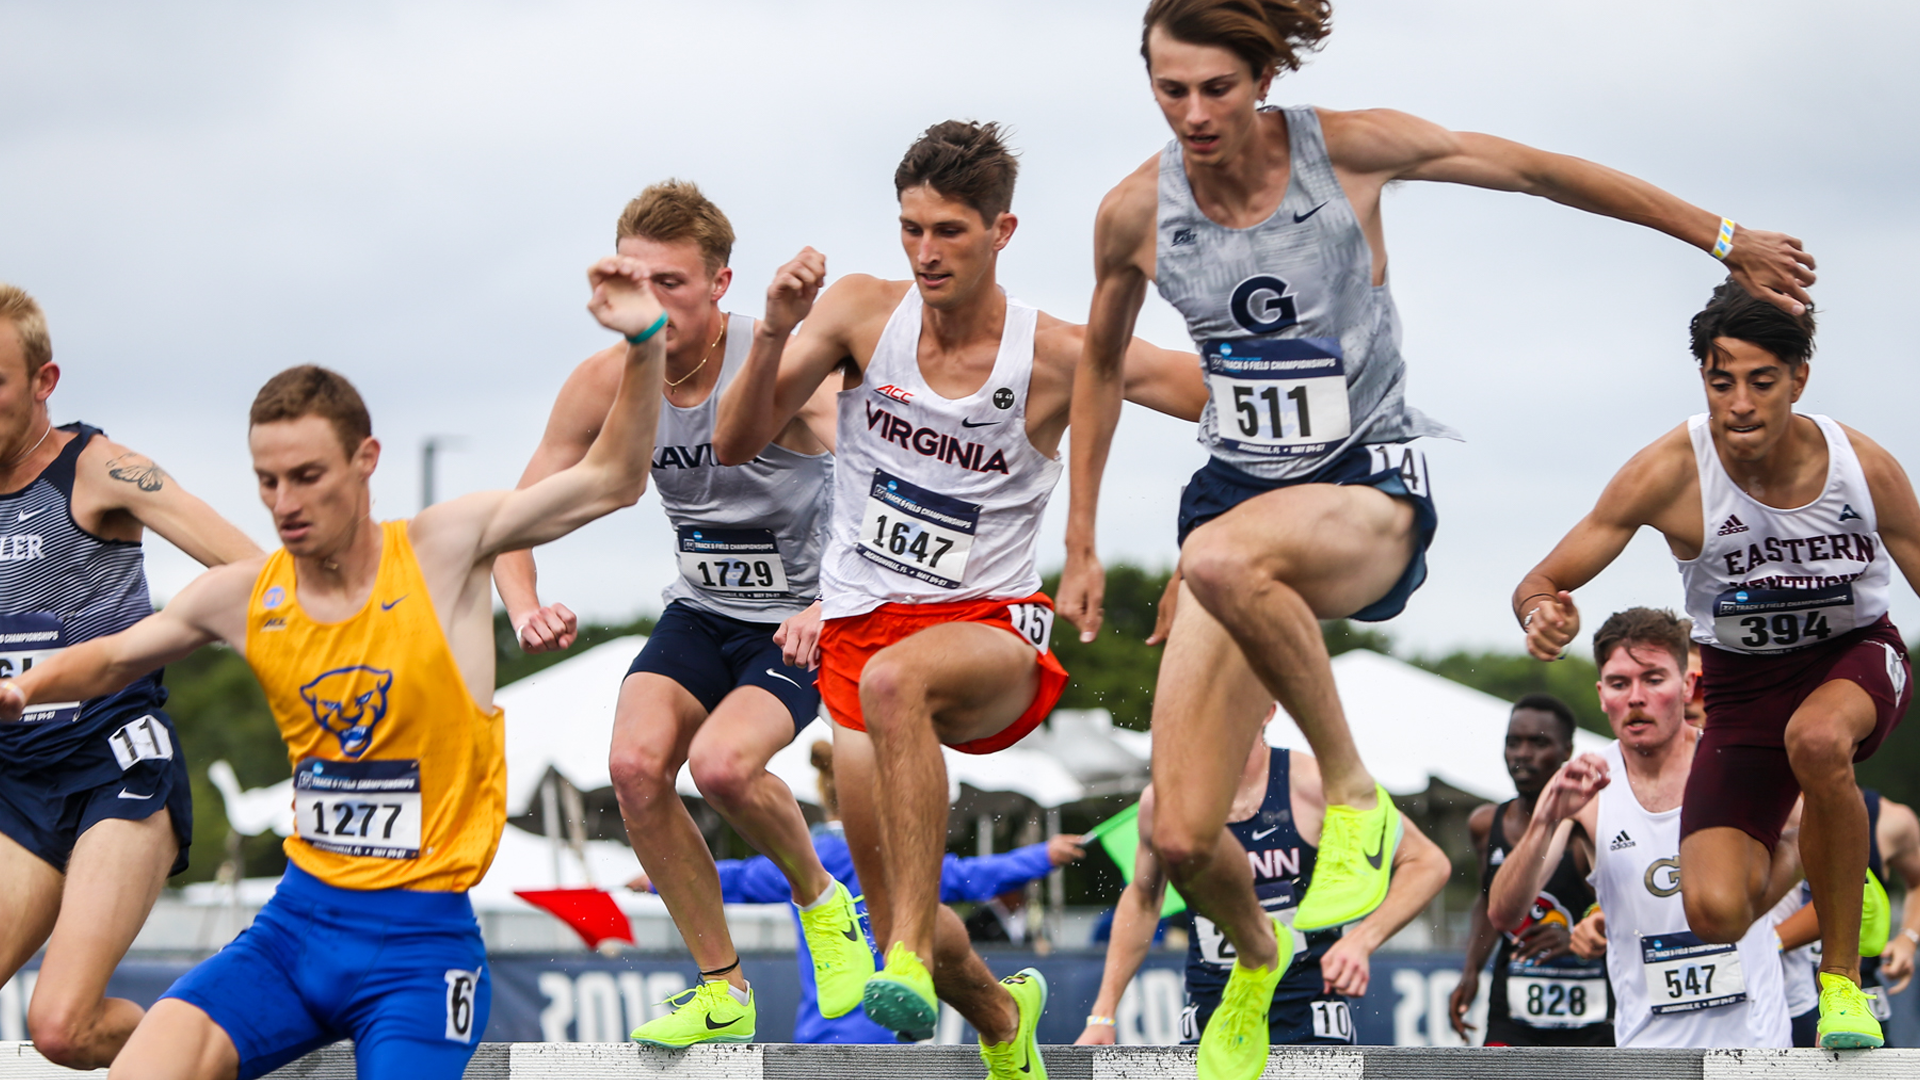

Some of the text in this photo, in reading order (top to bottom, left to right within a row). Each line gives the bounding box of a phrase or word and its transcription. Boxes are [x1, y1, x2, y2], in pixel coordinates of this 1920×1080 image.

[1229, 273, 1299, 335] G
[1249, 360, 1269, 371] FIELD
[1270, 358, 1336, 371] CHAMPIONSHIPS
[876, 384, 915, 404] ACC
[1232, 385, 1311, 439] 511
[866, 399, 1009, 475] VIRGINIA
[1374, 445, 1419, 490] 14
[904, 501, 921, 514] FIELD
[920, 508, 972, 529] CHAMPIONSHIPS
[1717, 525, 1750, 536] adidas
[872, 515, 954, 568] 1647
[1723, 533, 1875, 575] EASTERN
[697, 561, 773, 587] 1729
[916, 571, 931, 580] MAY
[1787, 595, 1847, 607] CHAMPIONSHIPS
[1019, 603, 1047, 645] 15
[1740, 611, 1831, 647] 394
[114, 718, 162, 762] 11
[357, 778, 415, 790] CHAMPIONSHIPS
[313, 801, 402, 839] 1277
[1610, 841, 1636, 851] adidas
[1664, 964, 1716, 998] 547
[452, 977, 472, 1036] 6
[1528, 984, 1586, 1016] 828
[1318, 1004, 1349, 1037] 10
